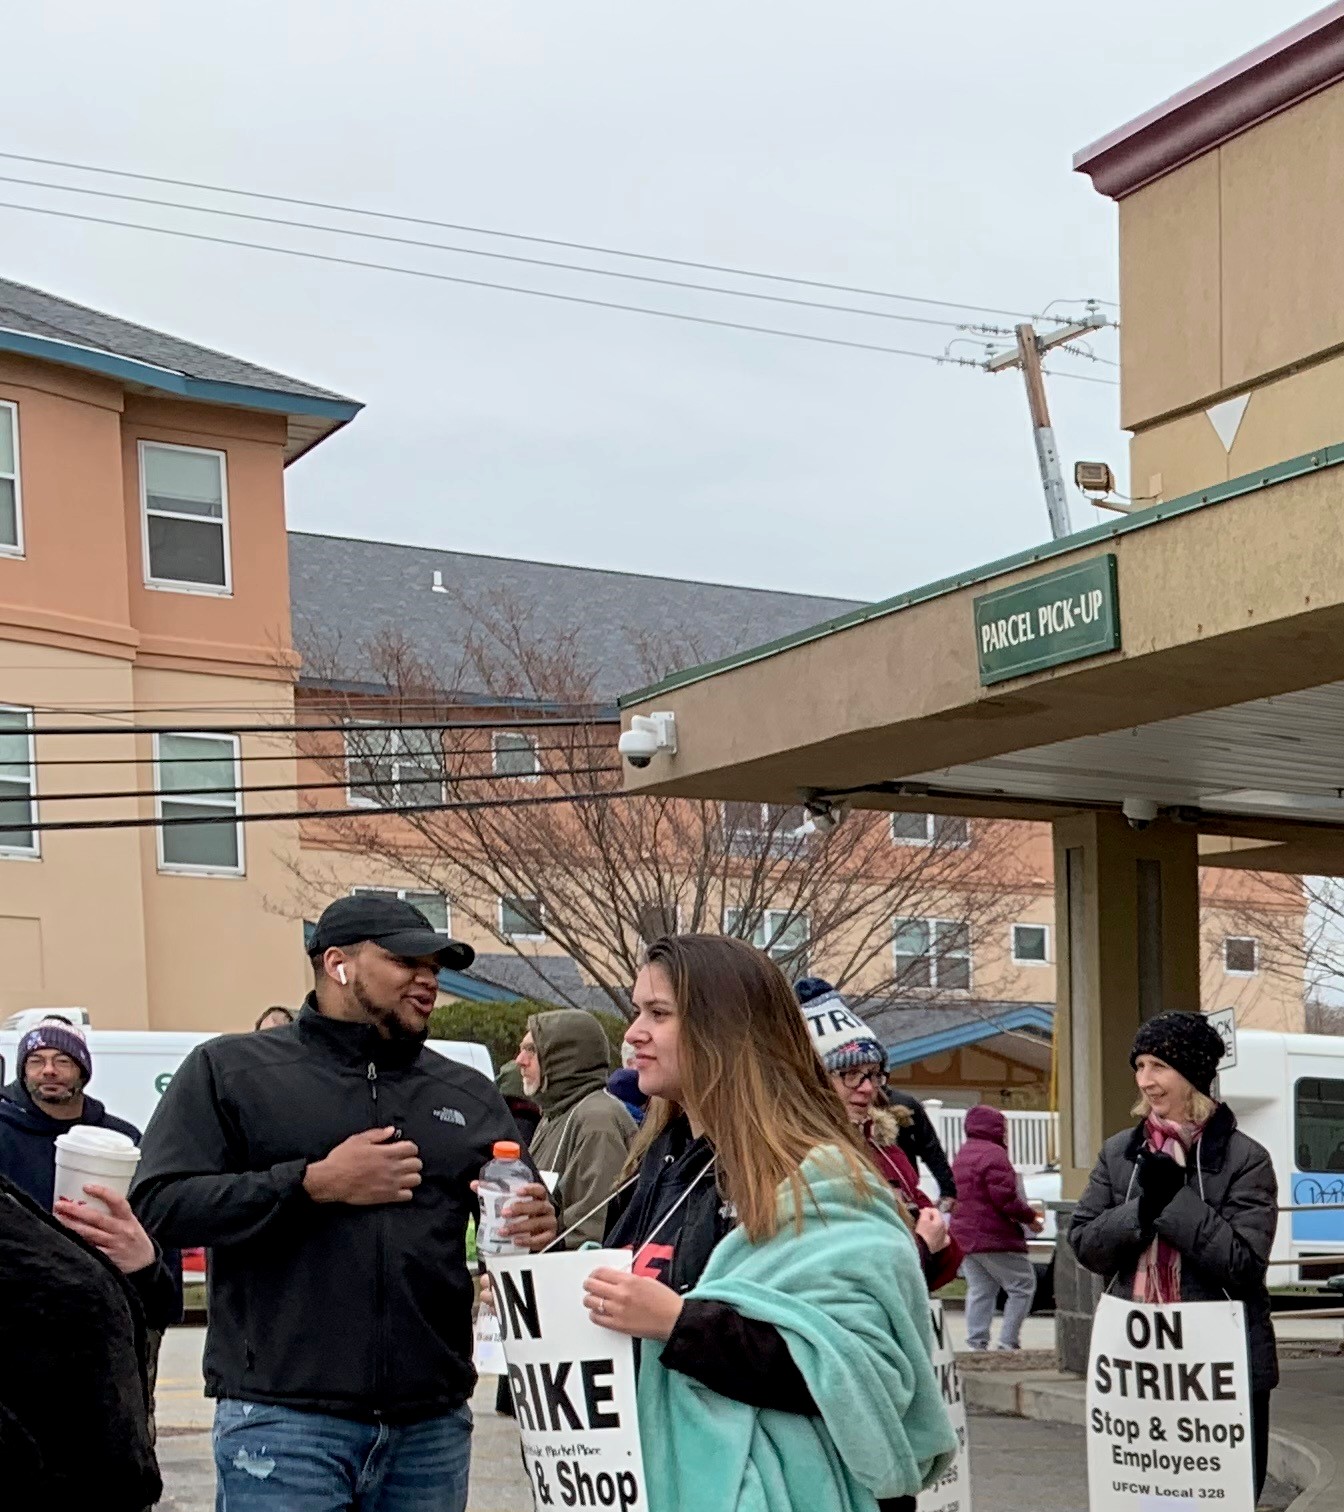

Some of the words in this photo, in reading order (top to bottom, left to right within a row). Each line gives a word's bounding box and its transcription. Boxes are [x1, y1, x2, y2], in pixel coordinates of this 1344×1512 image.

[981, 612, 1035, 654] PARCEL
[1038, 589, 1104, 637] PICK-UP
[1125, 1309, 1184, 1350] ON
[507, 1358, 620, 1431] RIKE
[1095, 1354, 1237, 1401] STRIKE
[1091, 1407, 1140, 1444] Stop
[1149, 1416, 1168, 1442] &
[1177, 1416, 1245, 1448] Shop
[1112, 1444, 1222, 1474] Employees
[535, 1460, 554, 1504] &
[1112, 1480, 1150, 1495] UFCW
[1155, 1485, 1193, 1498] Local
[1198, 1488, 1225, 1499] 328
